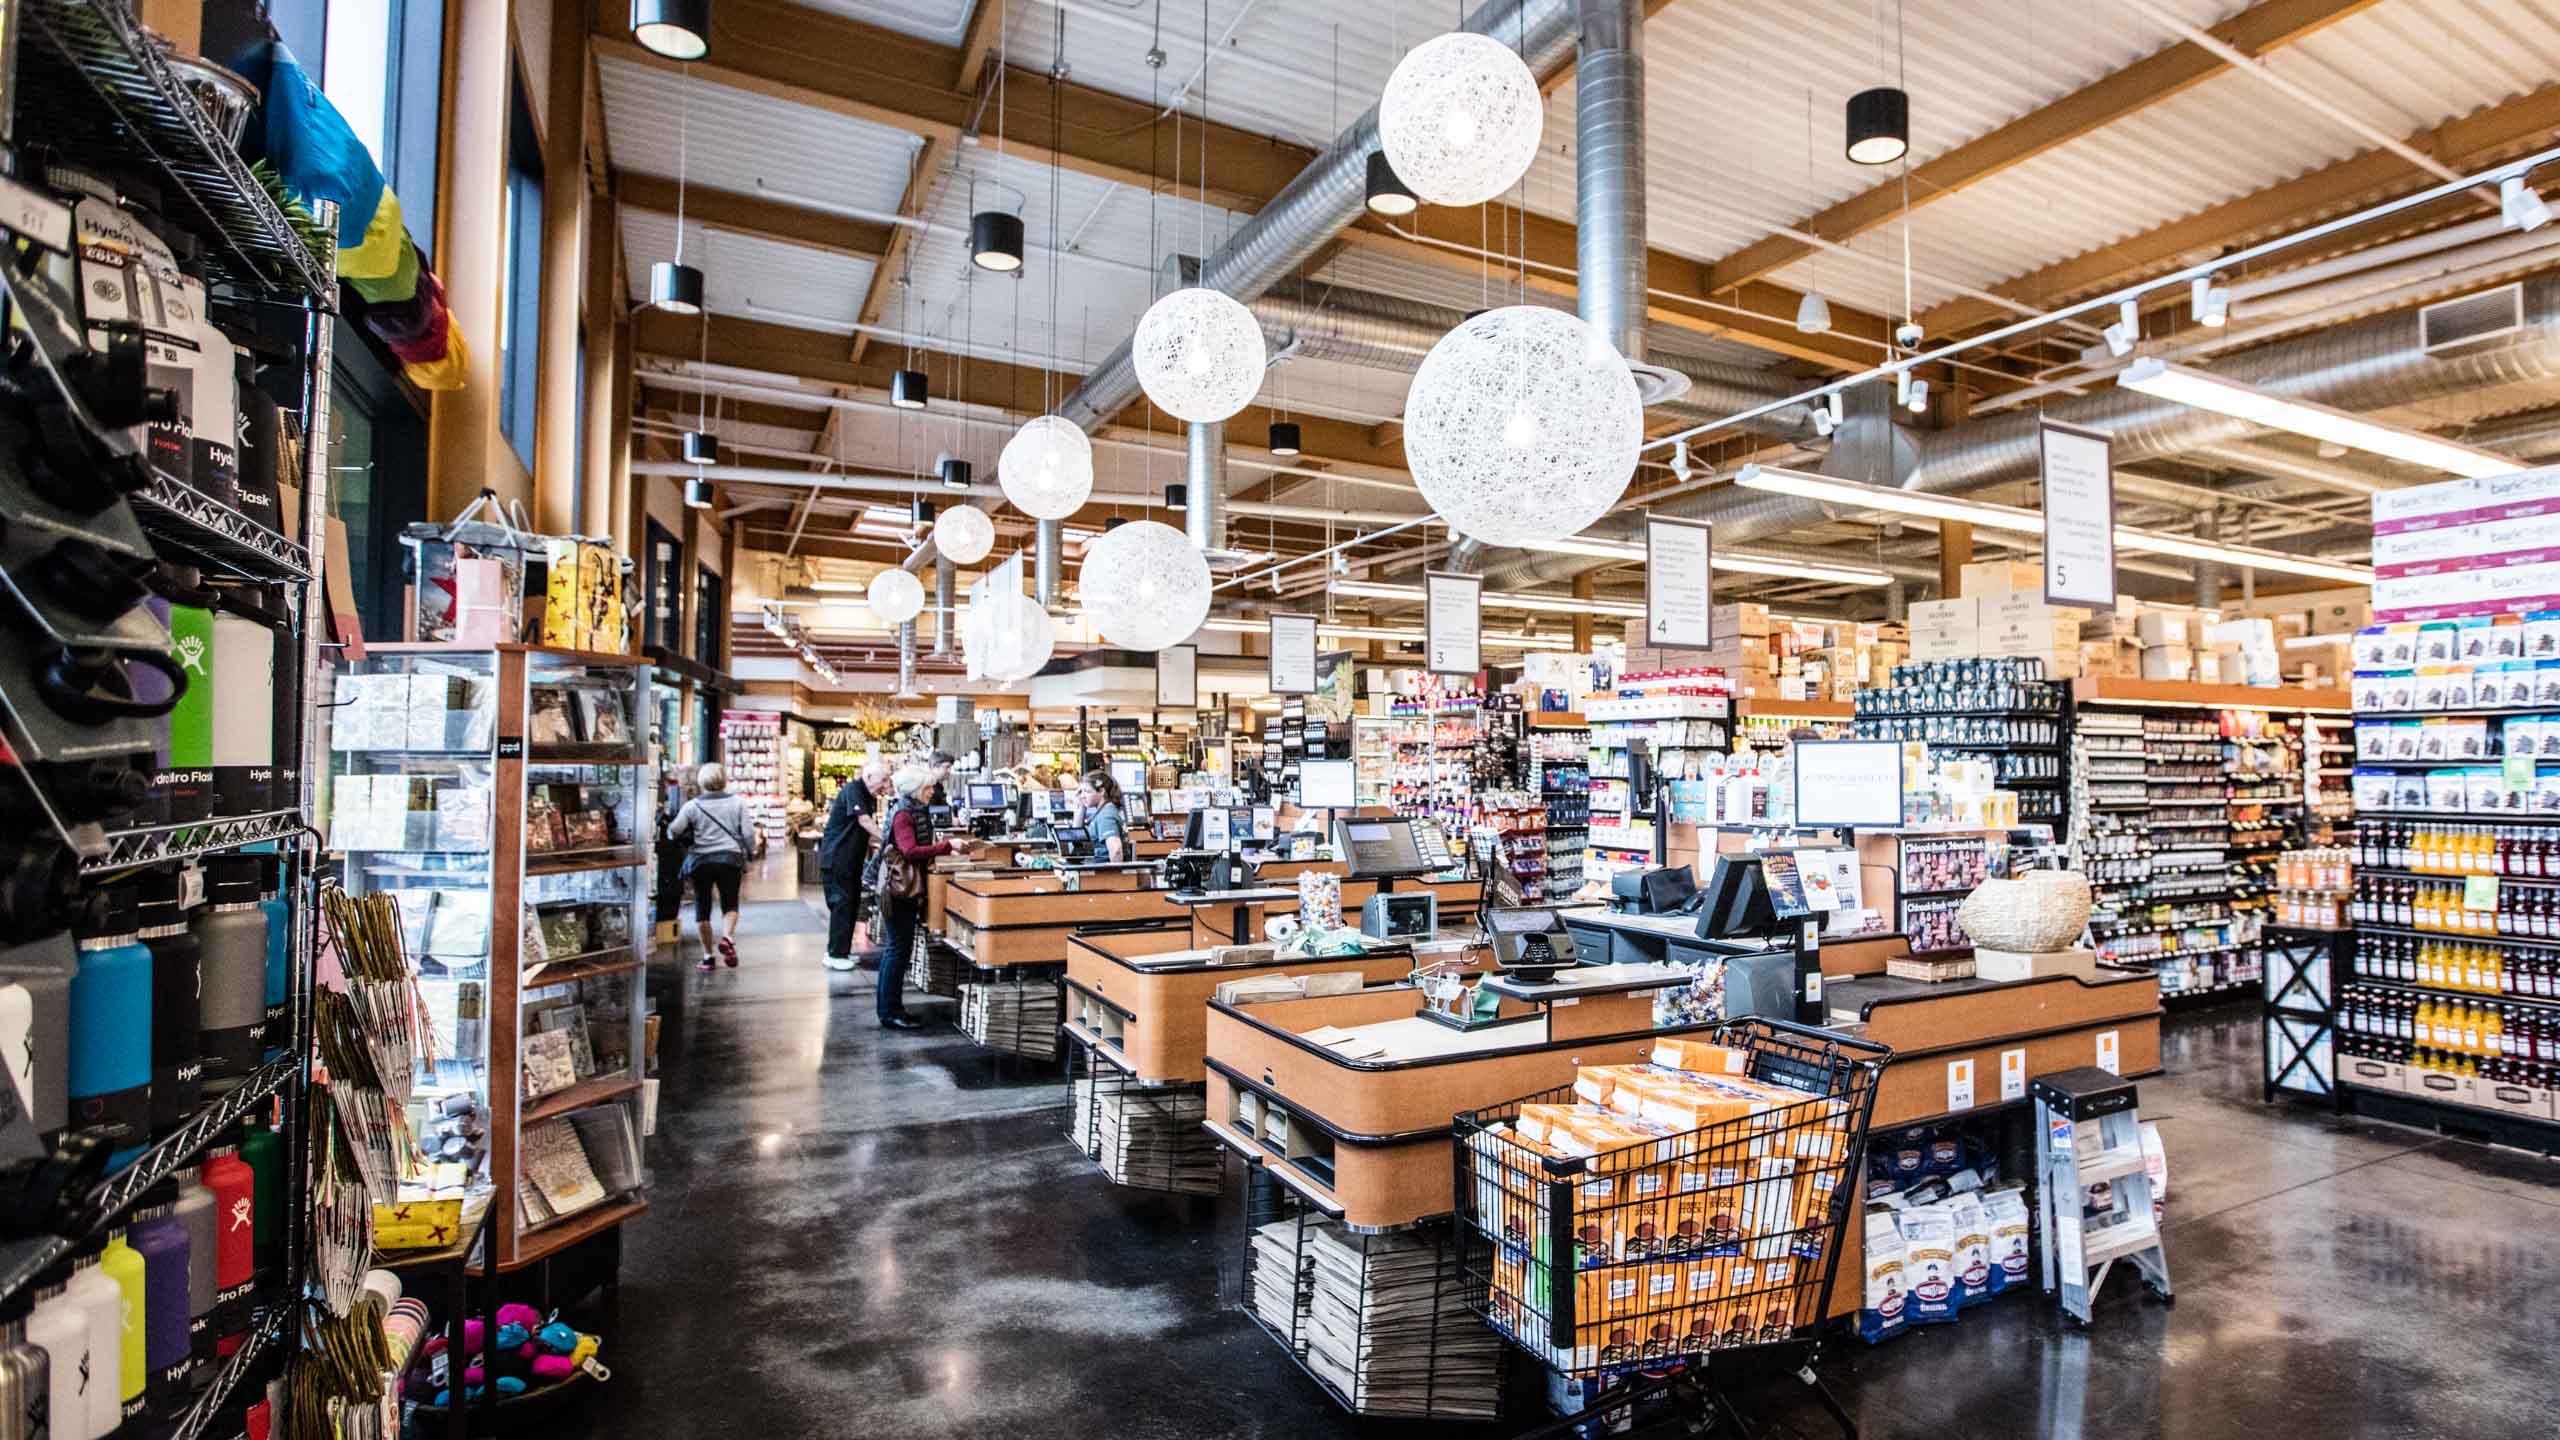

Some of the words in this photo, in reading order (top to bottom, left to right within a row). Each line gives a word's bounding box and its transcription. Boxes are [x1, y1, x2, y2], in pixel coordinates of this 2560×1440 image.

[2056, 565, 2067, 587] 5
[1658, 620, 1667, 634] 4
[1436, 651, 1444, 664] 3
[1277, 674, 1285, 686] 2
